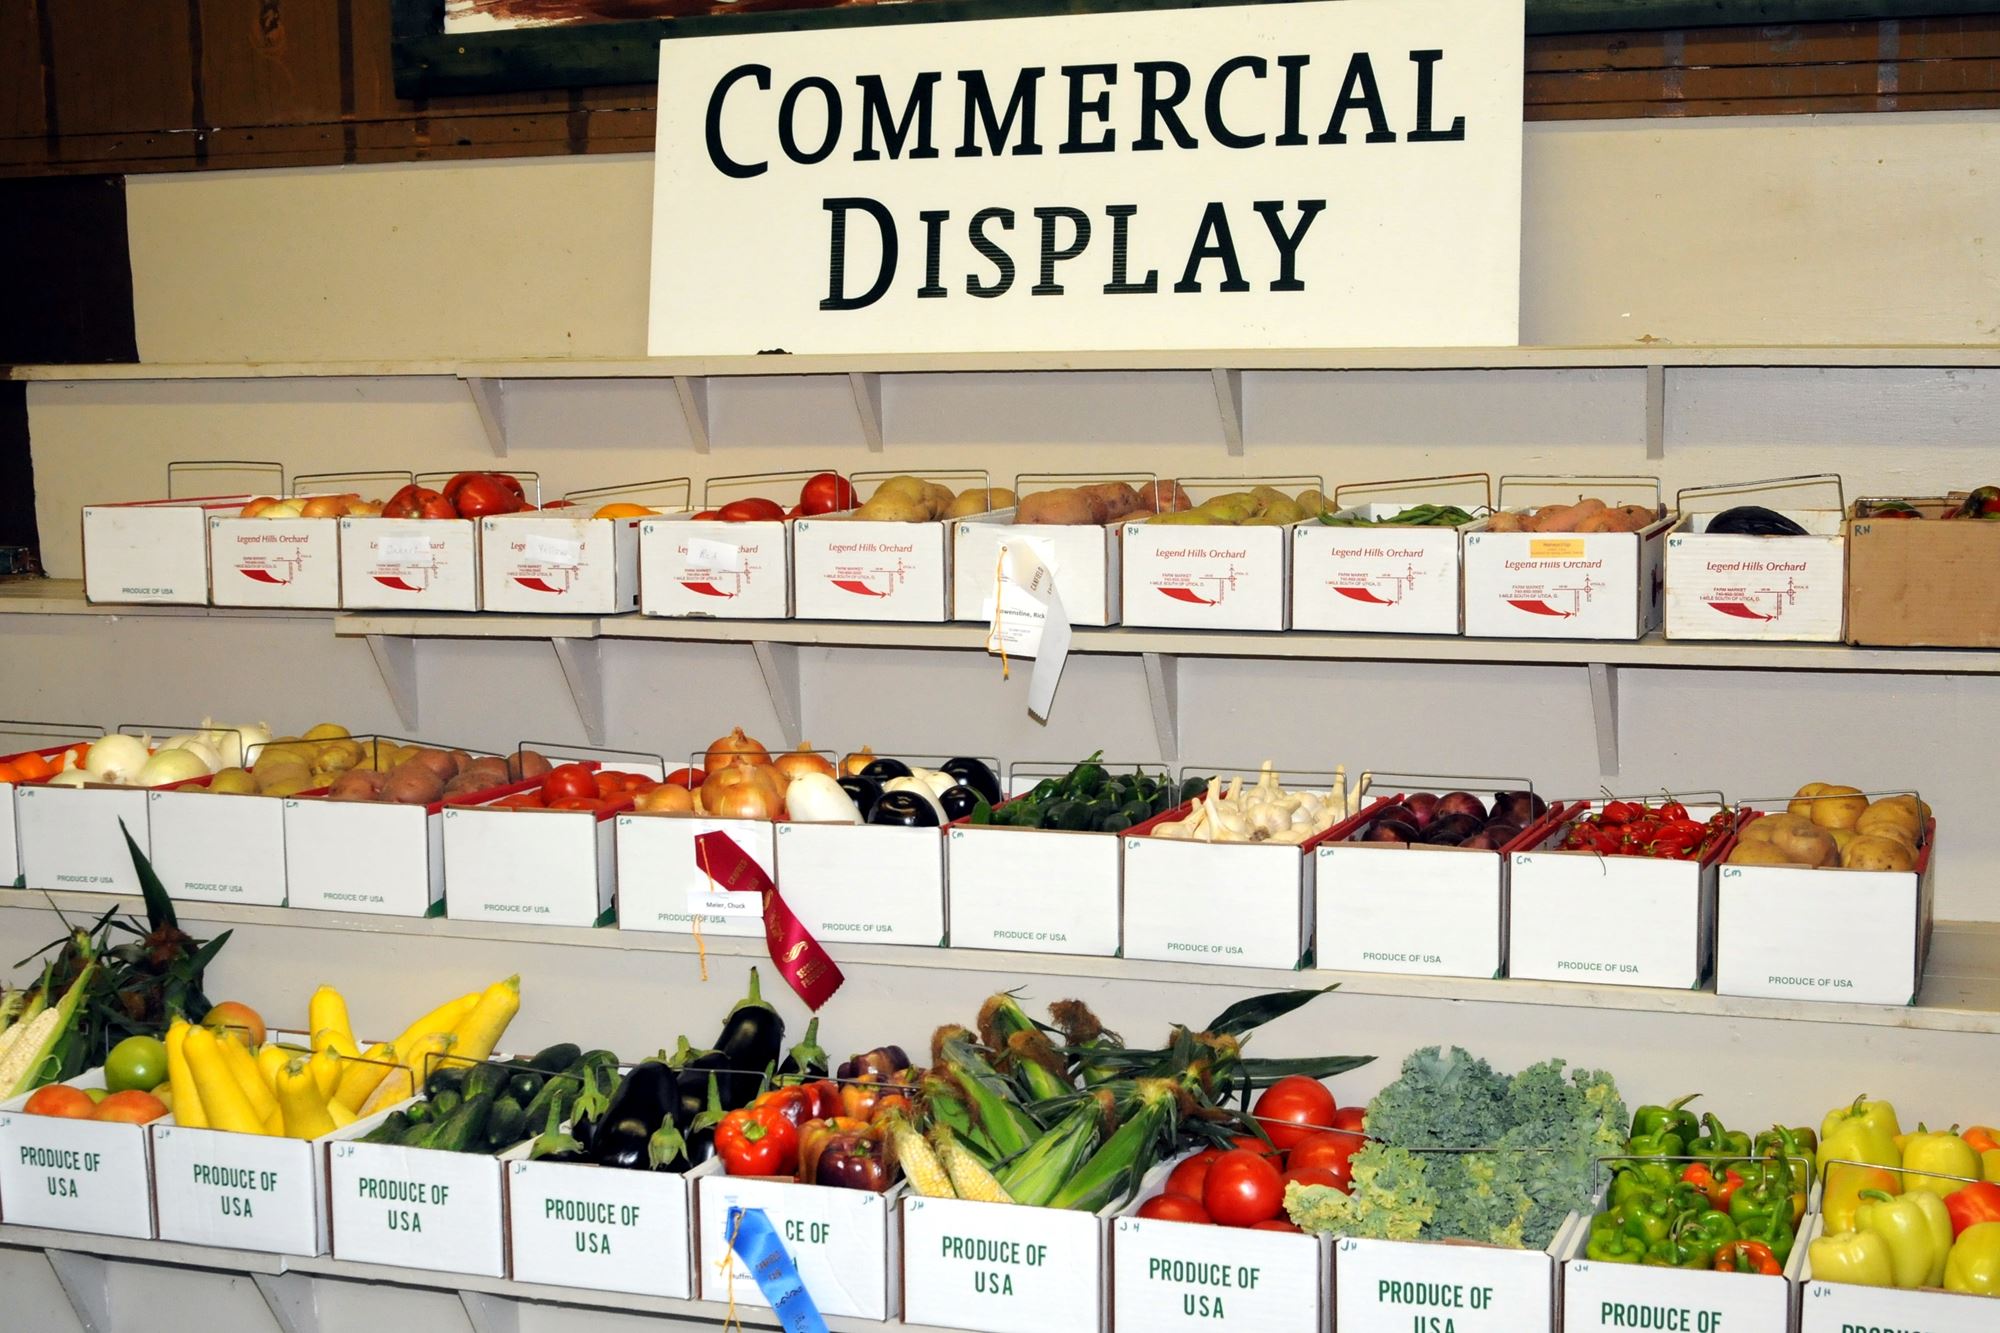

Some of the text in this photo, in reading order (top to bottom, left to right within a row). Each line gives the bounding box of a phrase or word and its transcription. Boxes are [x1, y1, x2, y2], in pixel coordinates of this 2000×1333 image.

[704, 49, 1466, 179] COMMERCIAL
[819, 197, 1326, 311] DISPLAY
[1298, 529, 1308, 537] RH
[1855, 524, 1870, 536] RH
[237, 535, 260, 544] Legend
[1669, 539, 1682, 547] RH
[829, 544, 912, 554] Legend Hills Orchard
[1156, 548, 1246, 559] Legend Hills Orchard
[1332, 548, 1424, 558] Legend Hills Orchard
[1505, 560, 1537, 570] Legend
[1563, 560, 1602, 568] Orchard
[1707, 562, 1806, 572] Legend Hills Orchard
[100, 876, 113, 884] USA
[185, 882, 217, 891] PRODUCE
[219, 884, 228, 892] OF
[323, 892, 384, 903] PRODUCE OF USA
[484, 904, 520, 912] PRODUCE
[706, 902, 746, 910] Meier, Chuck
[658, 914, 696, 922] PRODUCE
[710, 916, 726, 924] USA
[822, 923, 860, 931] PRODUCE
[863, 924, 873, 932] OF
[993, 930, 1066, 942] PRODUCE OF USA
[1168, 942, 1243, 954] PRODUCE OF USA
[1363, 952, 1441, 964] PRODUCE OF USA
[1558, 961, 1638, 973] PRODUCE OF USA
[1768, 976, 1853, 988] PRODUCE OF USA
[337, 1146, 355, 1158] JH
[20, 1146, 101, 1172] PRODUCE OF
[514, 1164, 528, 1174] JH
[194, 1164, 277, 1192] PRODUCE OF
[47, 1177, 78, 1198] USA
[359, 1177, 449, 1206] PRODUCE OF
[863, 1194, 875, 1206] JH
[909, 1200, 924, 1212] JH
[221, 1196, 253, 1218] USA
[545, 1198, 640, 1227] PRODUCE OF
[388, 1210, 422, 1233] USA
[810, 1222, 830, 1244] OF
[575, 1232, 611, 1255] USA
[1340, 1240, 1358, 1252] JH
[942, 1236, 1047, 1267] PRODUCE OF
[1149, 1258, 1261, 1290] PRODUCE OF
[974, 1271, 1013, 1296] USA
[1379, 1280, 1493, 1310] PRODUCE OF
[1814, 1286, 1831, 1298] JH
[1183, 1294, 1224, 1320] USA
[1601, 1302, 1722, 1333] PRODUCE OF
[1414, 1316, 1456, 1333] USA
